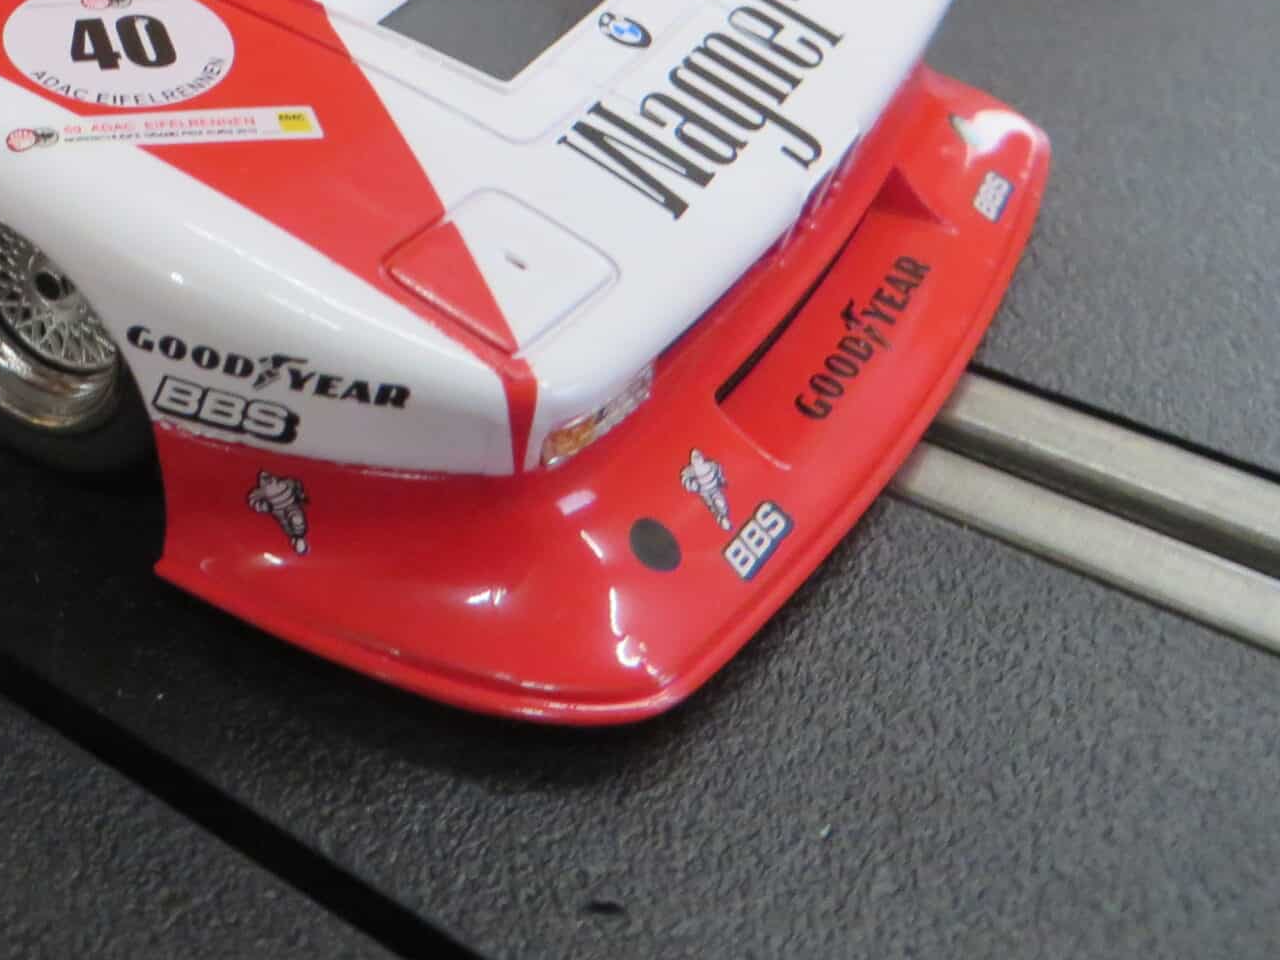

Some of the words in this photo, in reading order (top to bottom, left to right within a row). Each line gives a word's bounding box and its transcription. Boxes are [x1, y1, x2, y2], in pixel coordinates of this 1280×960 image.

[70, 13, 177, 71] 40
[31, 69, 90, 101] ADAC
[151, 374, 300, 444] BBS
[724, 500, 794, 580] BBS
